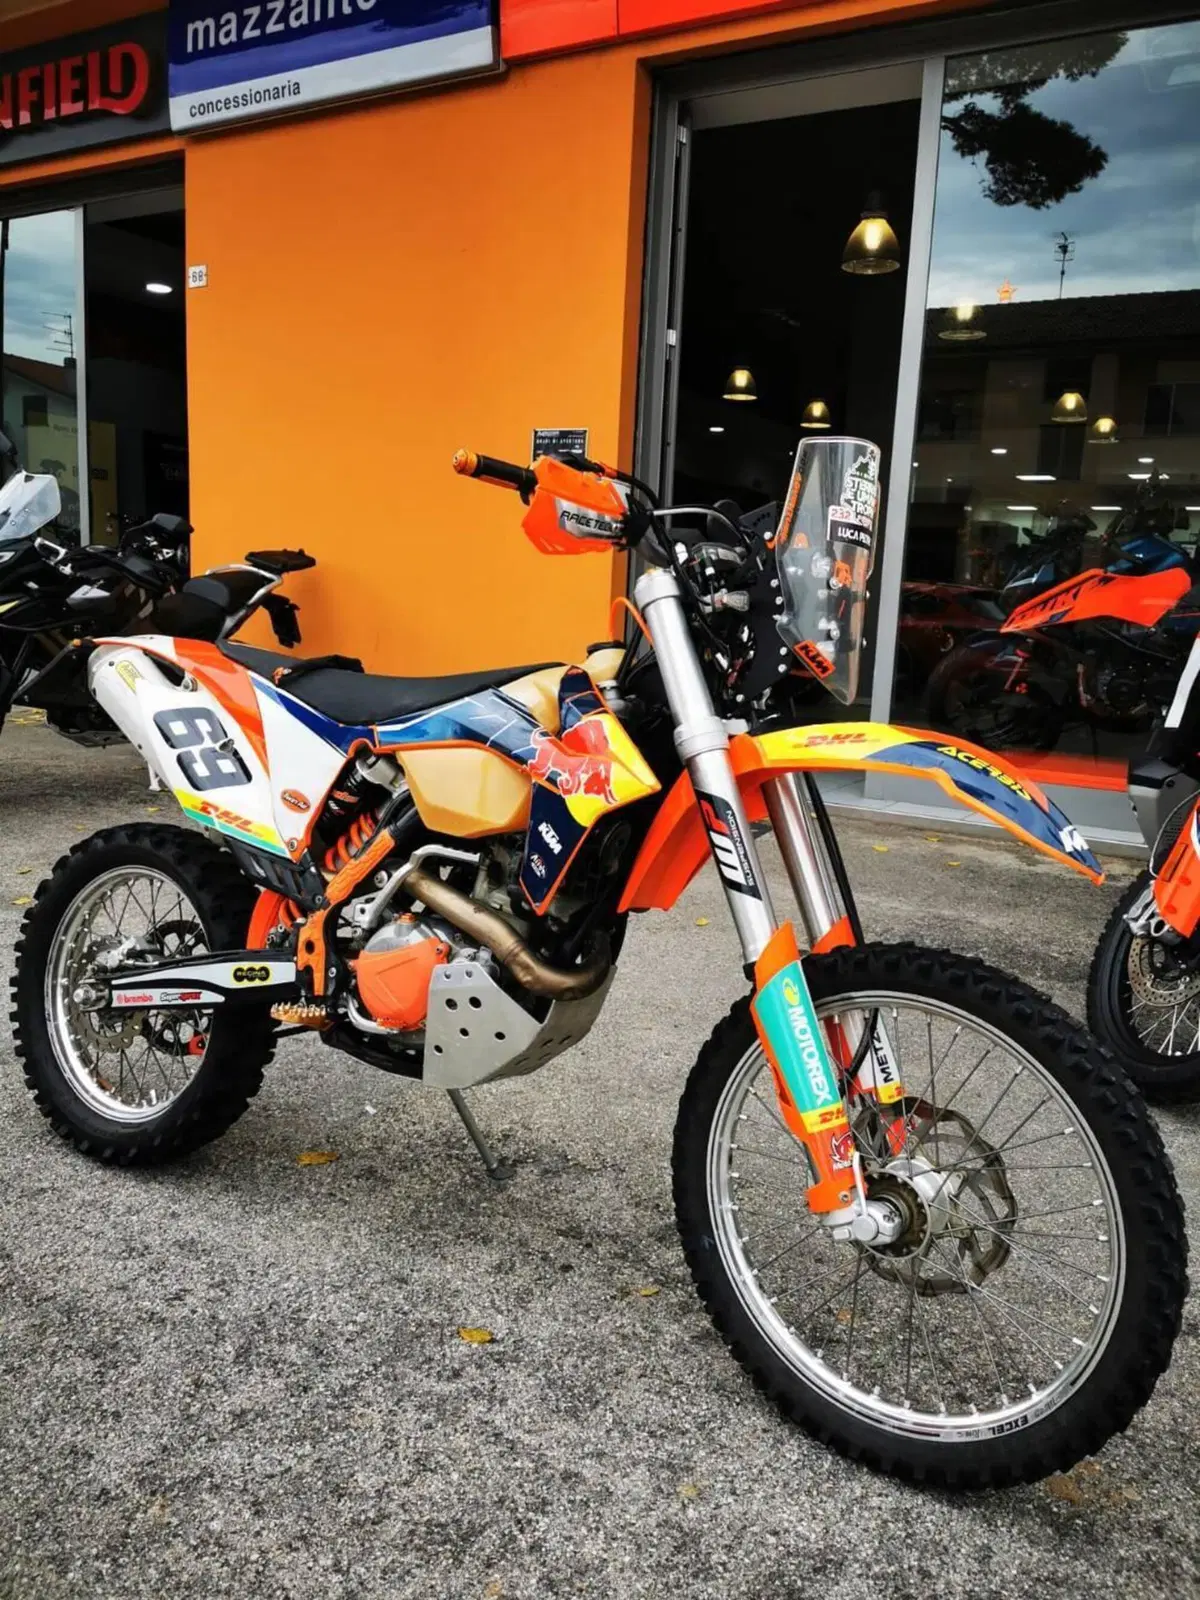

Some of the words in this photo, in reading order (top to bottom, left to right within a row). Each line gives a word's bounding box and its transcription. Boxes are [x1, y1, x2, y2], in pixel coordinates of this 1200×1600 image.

[189, 80, 301, 118] concessionaria
[838, 526, 859, 541] LUCA
[153, 707, 253, 792] 69
[936, 746, 1032, 801] ACERBIS
[199, 800, 254, 833] DHL
[537, 820, 563, 856] KTM
[725, 809, 756, 887] SUSPENSION
[788, 1004, 833, 1107] MOTOREX
[819, 1107, 845, 1124] DH
[987, 1414, 1030, 1436] EXCEL
